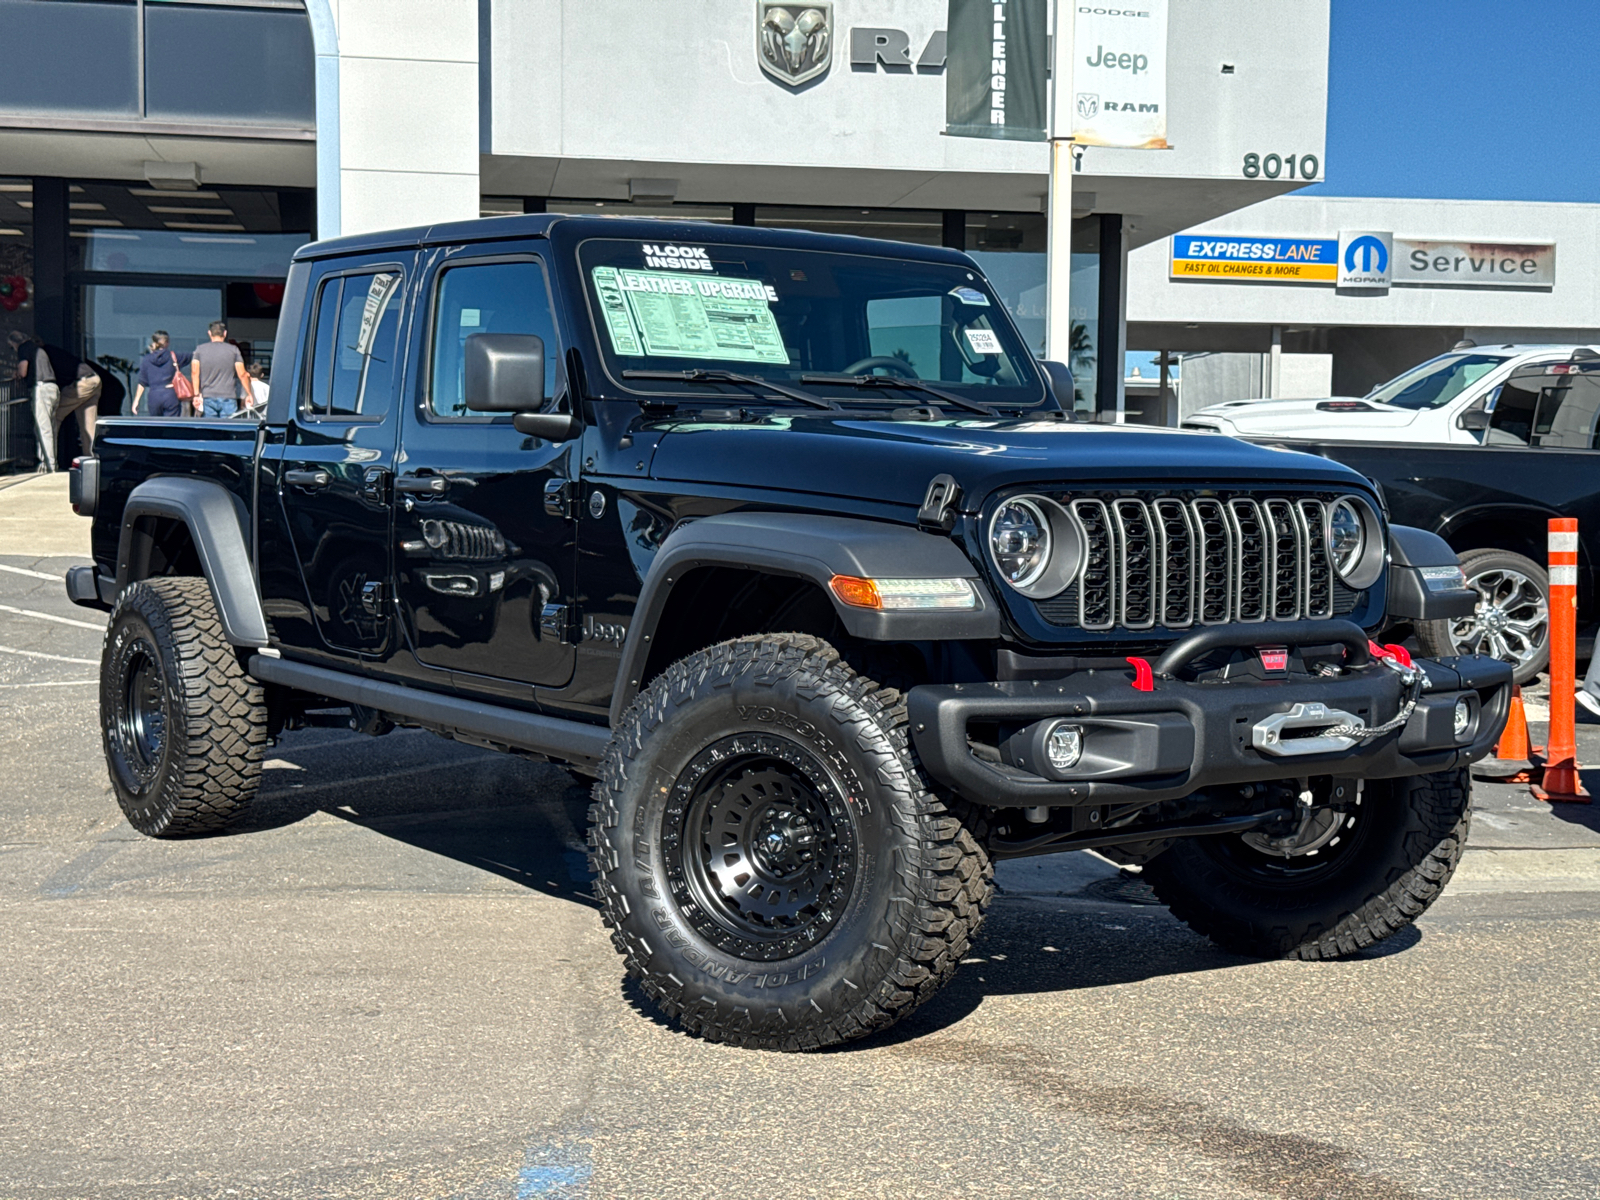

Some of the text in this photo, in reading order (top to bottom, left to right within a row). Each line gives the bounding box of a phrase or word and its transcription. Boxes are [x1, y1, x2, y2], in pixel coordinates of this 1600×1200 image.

[1078, 6, 1151, 18] DODGE
[990, 0, 1007, 125] LLENGER
[1086, 45, 1149, 75] Jeep
[1104, 101, 1159, 114] RAM
[1242, 152, 1319, 180] 8010
[645, 256, 714, 271] INSIDE
[652, 245, 709, 259] LOOK
[1409, 249, 1538, 275] Service
[1184, 263, 1301, 276] FAST OIL CHANGES & MORE
[616, 272, 779, 302] LEATHER UPGRADE
[1032, 304, 1088, 320] Leng
[582, 615, 626, 648] Jeep
[586, 647, 622, 660] GLADIATO
[736, 705, 872, 816] YOKOHAMA
[652, 906, 826, 989] GEOLANDAR
